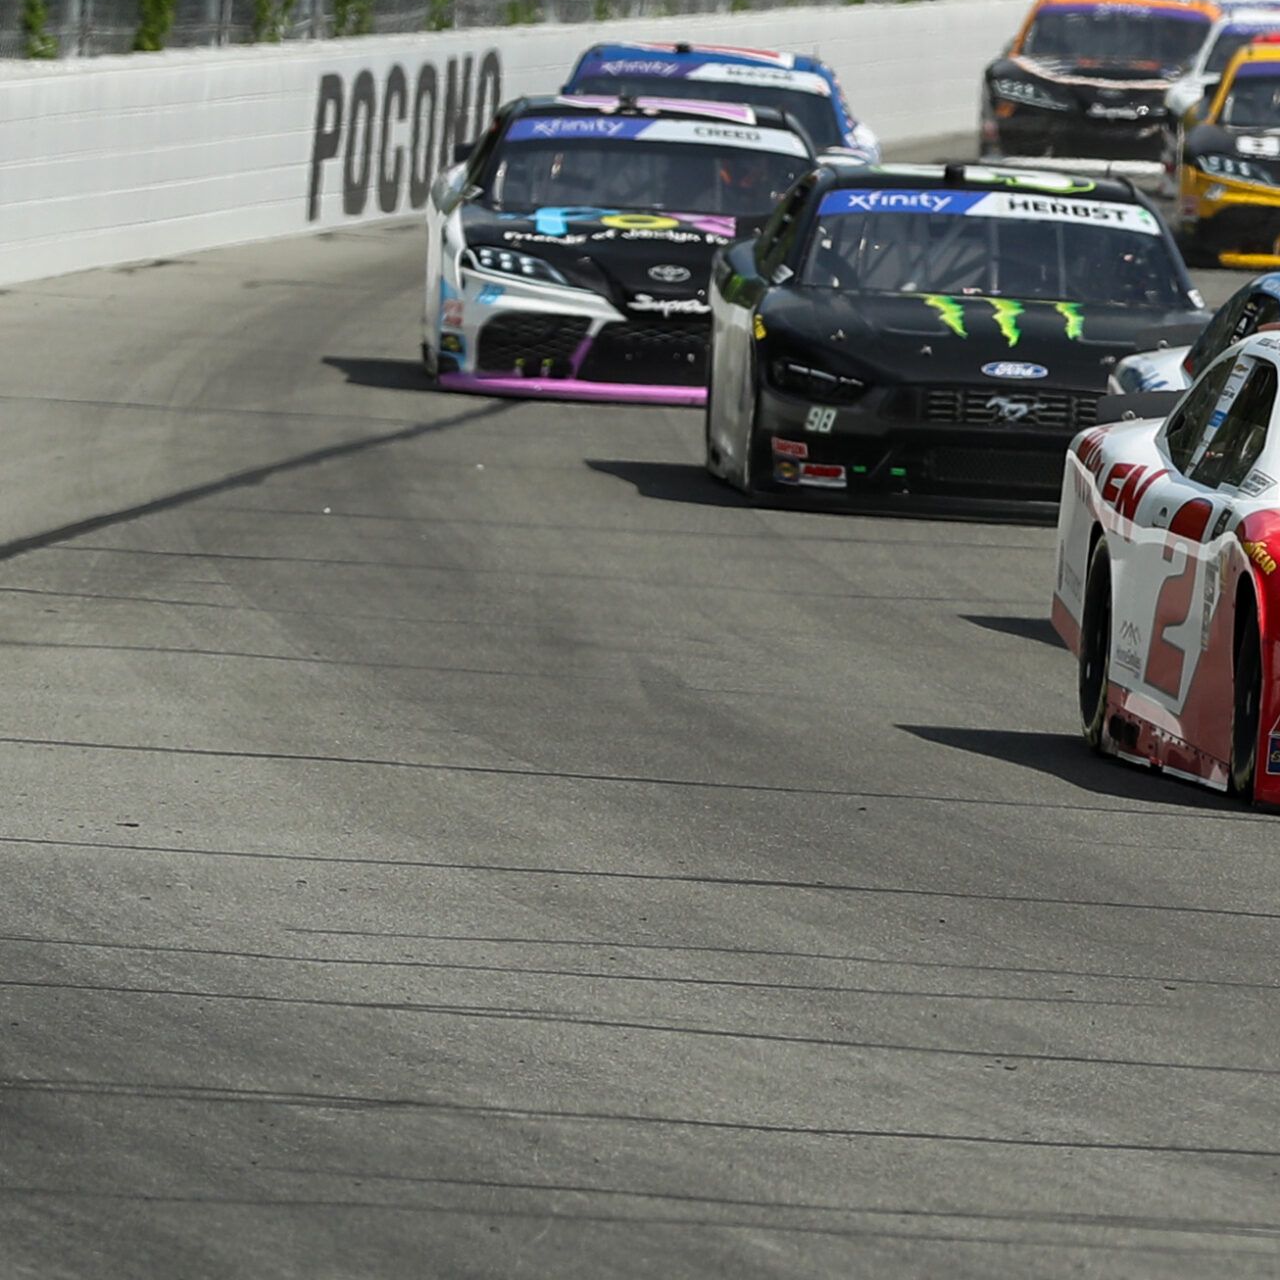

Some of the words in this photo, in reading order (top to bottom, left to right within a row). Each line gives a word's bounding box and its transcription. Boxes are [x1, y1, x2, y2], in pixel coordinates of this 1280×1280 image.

[308, 47, 501, 222] POCONO
[694, 126, 763, 143] CREED
[848, 191, 952, 212] xfinity
[1008, 199, 1128, 222] HERBST
[805, 406, 837, 433] 98
